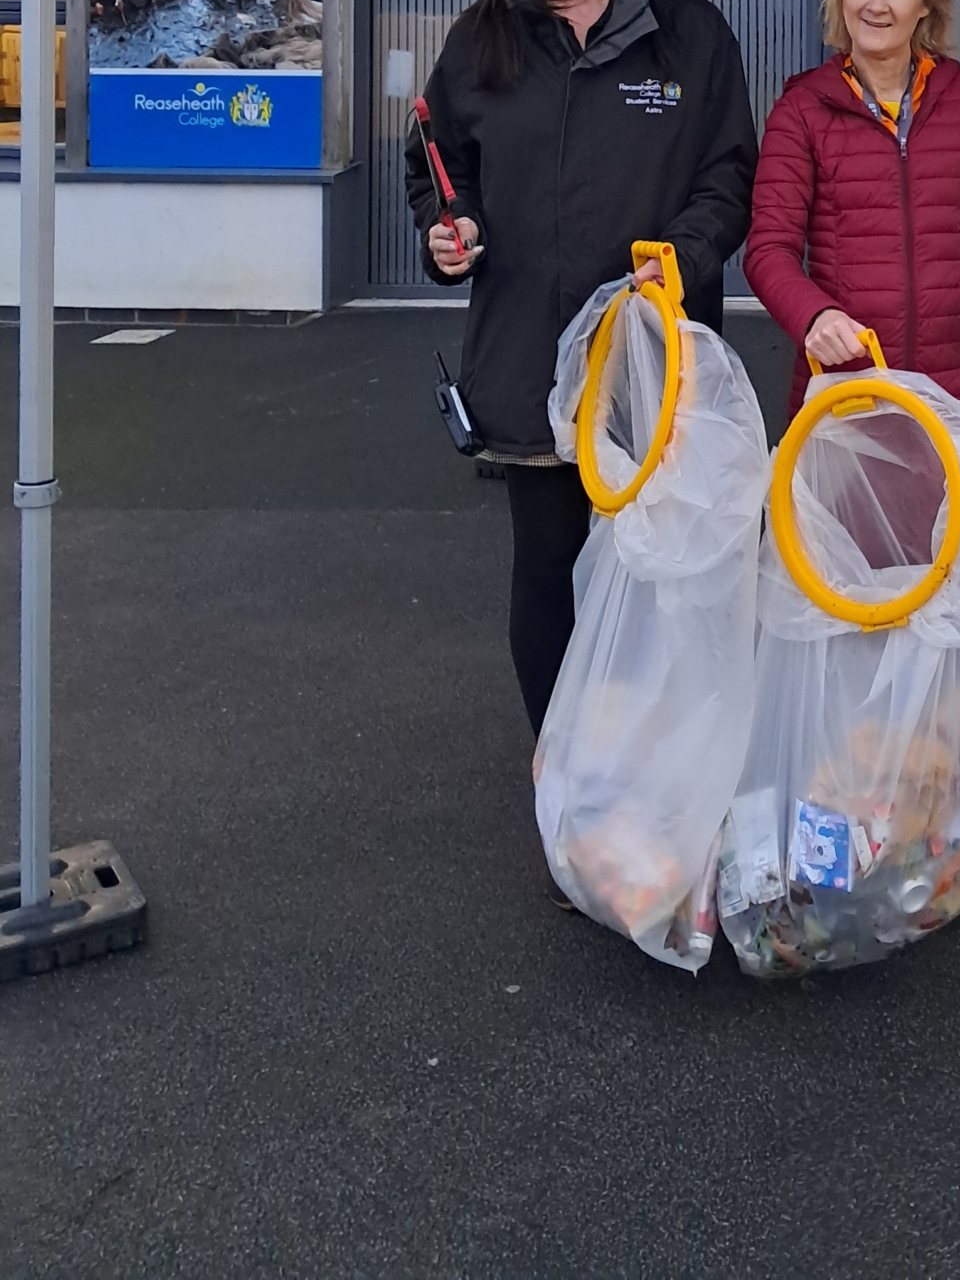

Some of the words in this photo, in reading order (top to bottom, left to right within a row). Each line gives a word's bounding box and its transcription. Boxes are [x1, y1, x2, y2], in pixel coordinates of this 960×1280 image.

[619, 82, 661, 91] Reaseheath
[135, 94, 225, 111] Reaseheath
[178, 112, 225, 128] College
